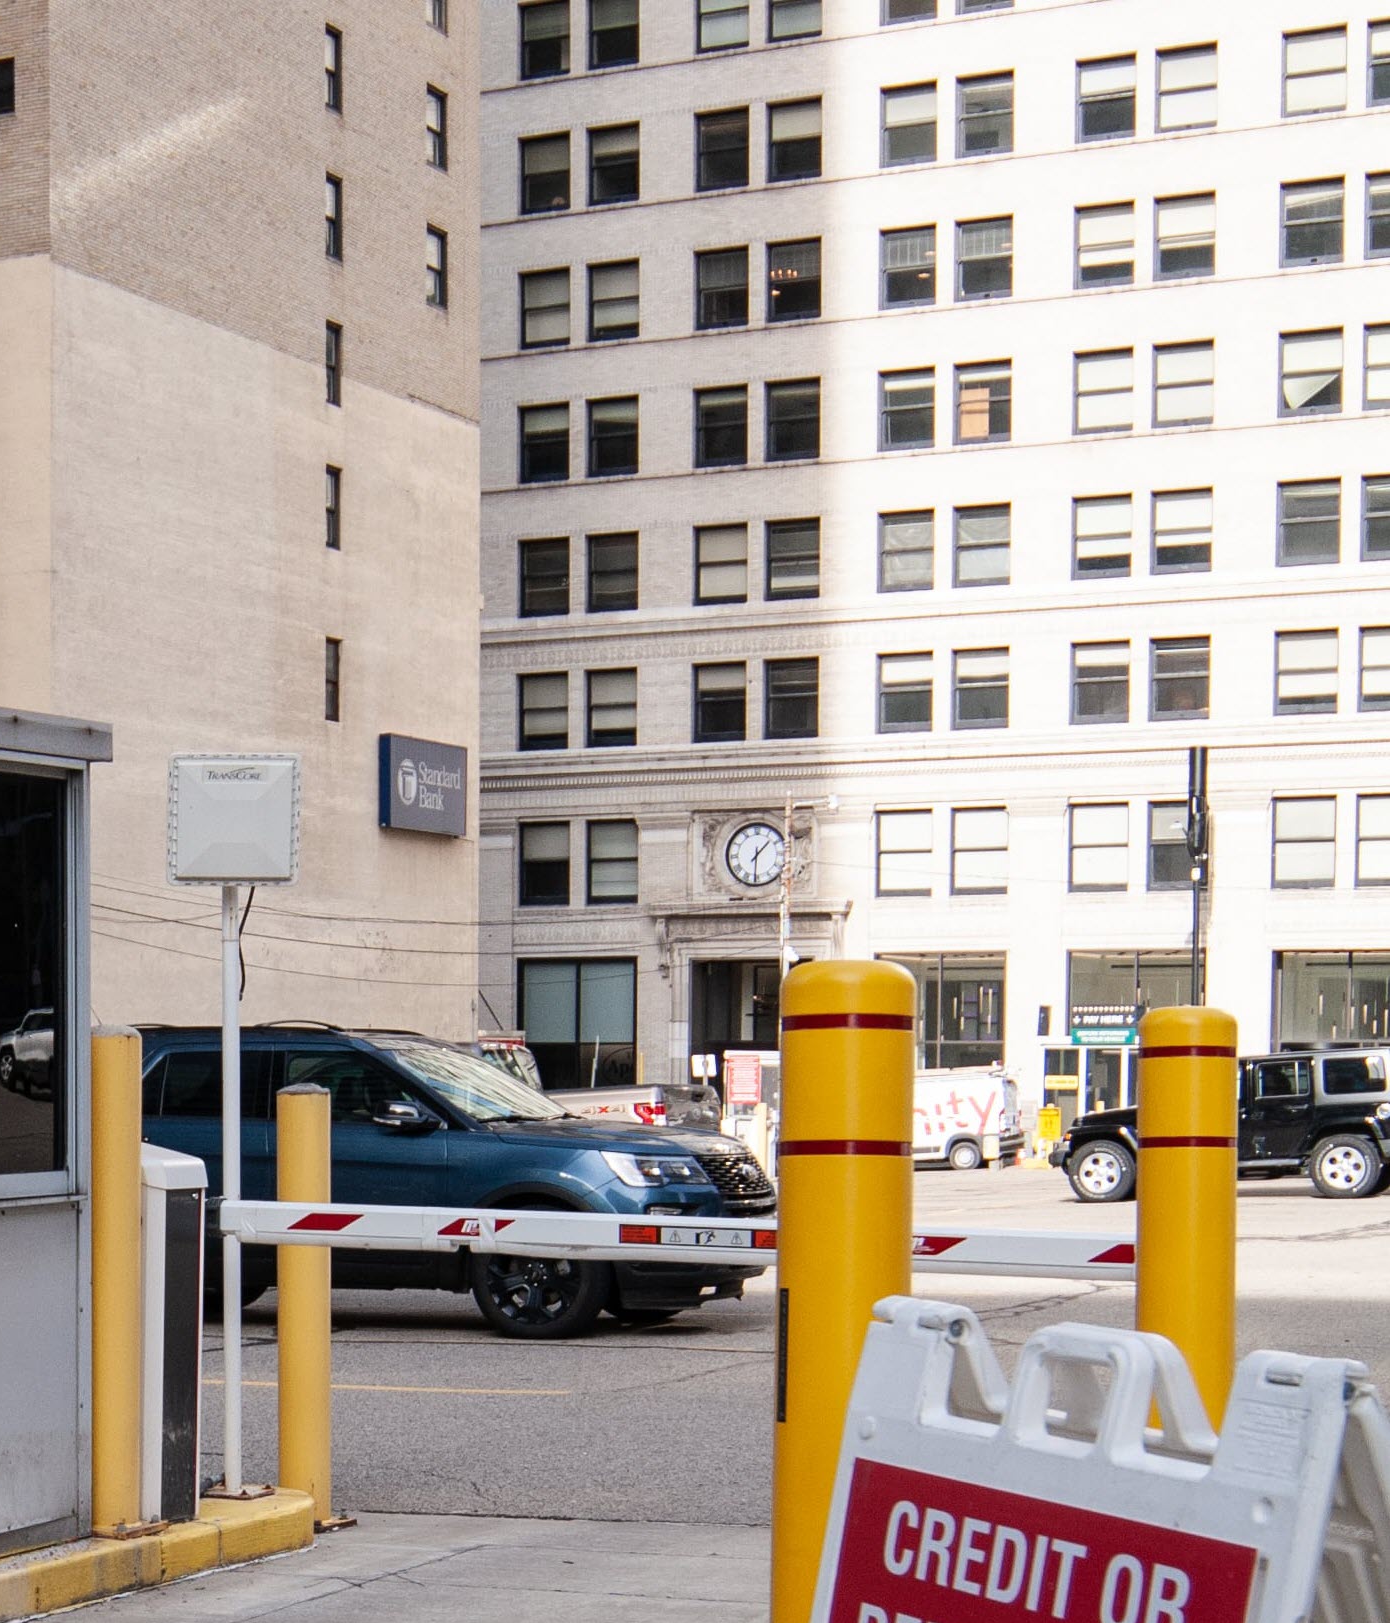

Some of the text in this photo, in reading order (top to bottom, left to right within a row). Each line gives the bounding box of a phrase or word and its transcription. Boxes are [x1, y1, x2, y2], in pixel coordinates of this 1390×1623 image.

[418, 761, 461, 790] Standard
[418, 786, 445, 811] Bank
[883, 1500, 1088, 1619] CREDIT
